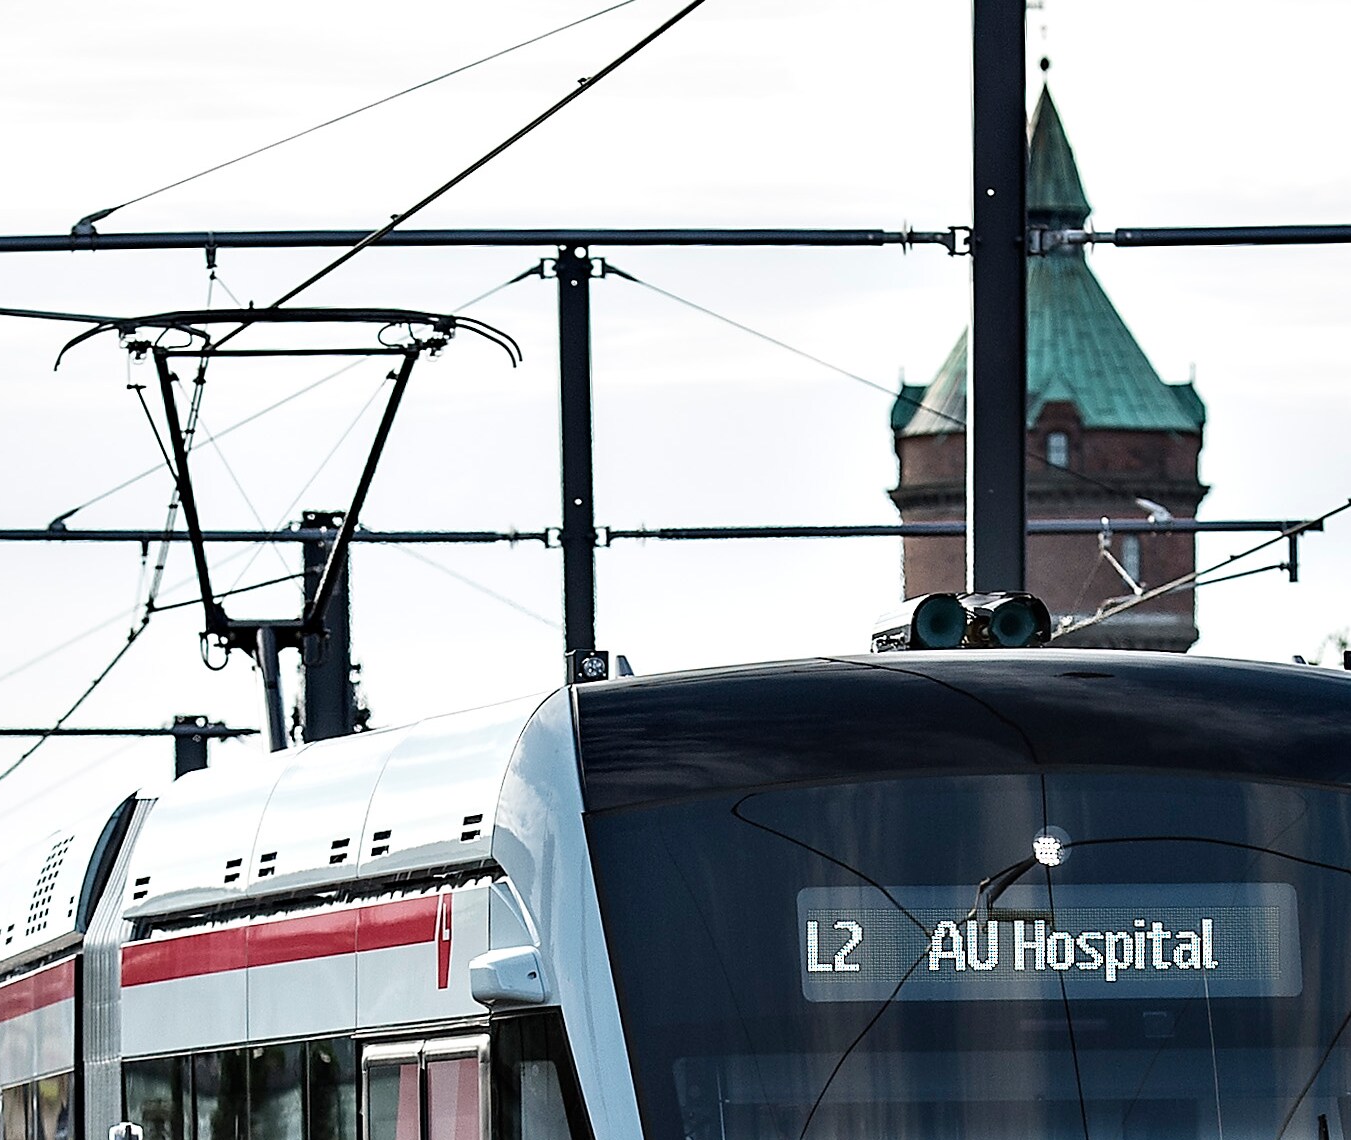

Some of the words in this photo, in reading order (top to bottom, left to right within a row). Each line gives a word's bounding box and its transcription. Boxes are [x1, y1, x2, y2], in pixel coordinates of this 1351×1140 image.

[806, 919, 864, 973] L2
[928, 919, 999, 972] AU
[1013, 918, 1219, 983] Hospital
